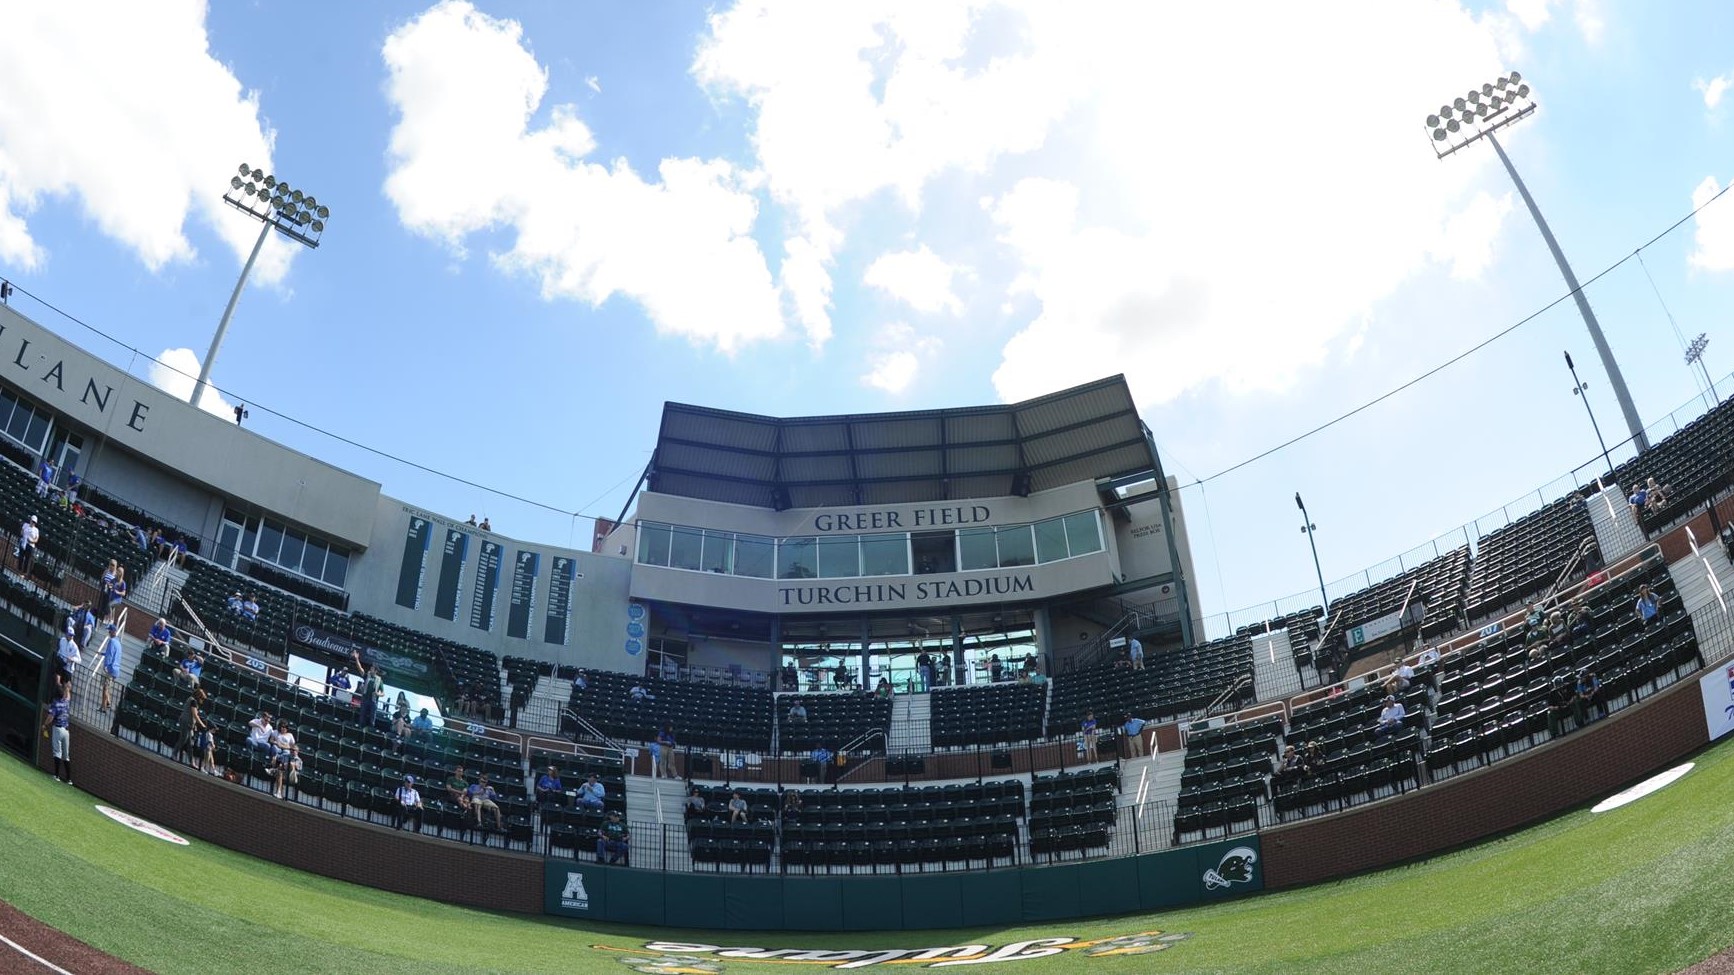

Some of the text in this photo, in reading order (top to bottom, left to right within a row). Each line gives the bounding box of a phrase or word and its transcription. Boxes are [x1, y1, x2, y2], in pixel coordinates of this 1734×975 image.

[0, 326, 149, 433] LANE
[815, 505, 990, 531] GREER FIELD
[779, 574, 1034, 605] TURCHIN STADIUM
[562, 872, 588, 900] A
[645, 937, 1079, 968] Tulane
